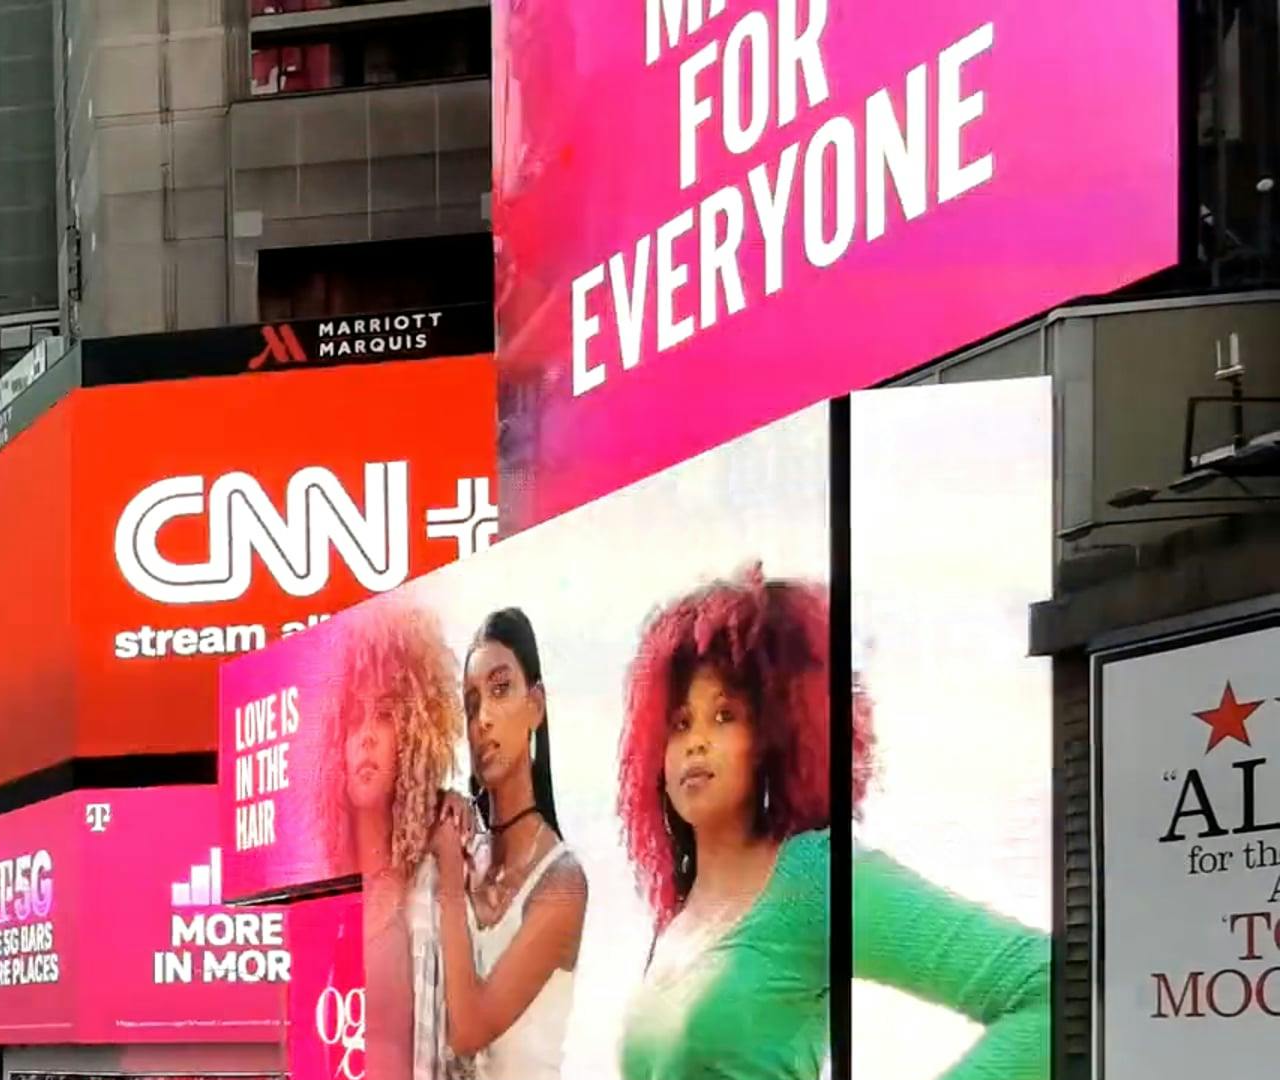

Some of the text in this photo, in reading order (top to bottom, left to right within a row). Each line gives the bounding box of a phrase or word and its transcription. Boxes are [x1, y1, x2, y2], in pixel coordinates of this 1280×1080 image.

[680, 0, 830, 190] FOR
[572, 22, 994, 397] EVERYONE
[319, 312, 442, 337] MARRIOTT
[320, 334, 427, 357] MARQUIS
[115, 622, 266, 657] stream
[235, 686, 300, 752] LOVE IS
[235, 742, 290, 802] IN THE
[235, 806, 276, 852] HAIR
[1188, 845, 1233, 875] for
[172, 912, 283, 948] MORE
[12, 954, 59, 986] PLACES
[153, 949, 290, 985] IN MOR
